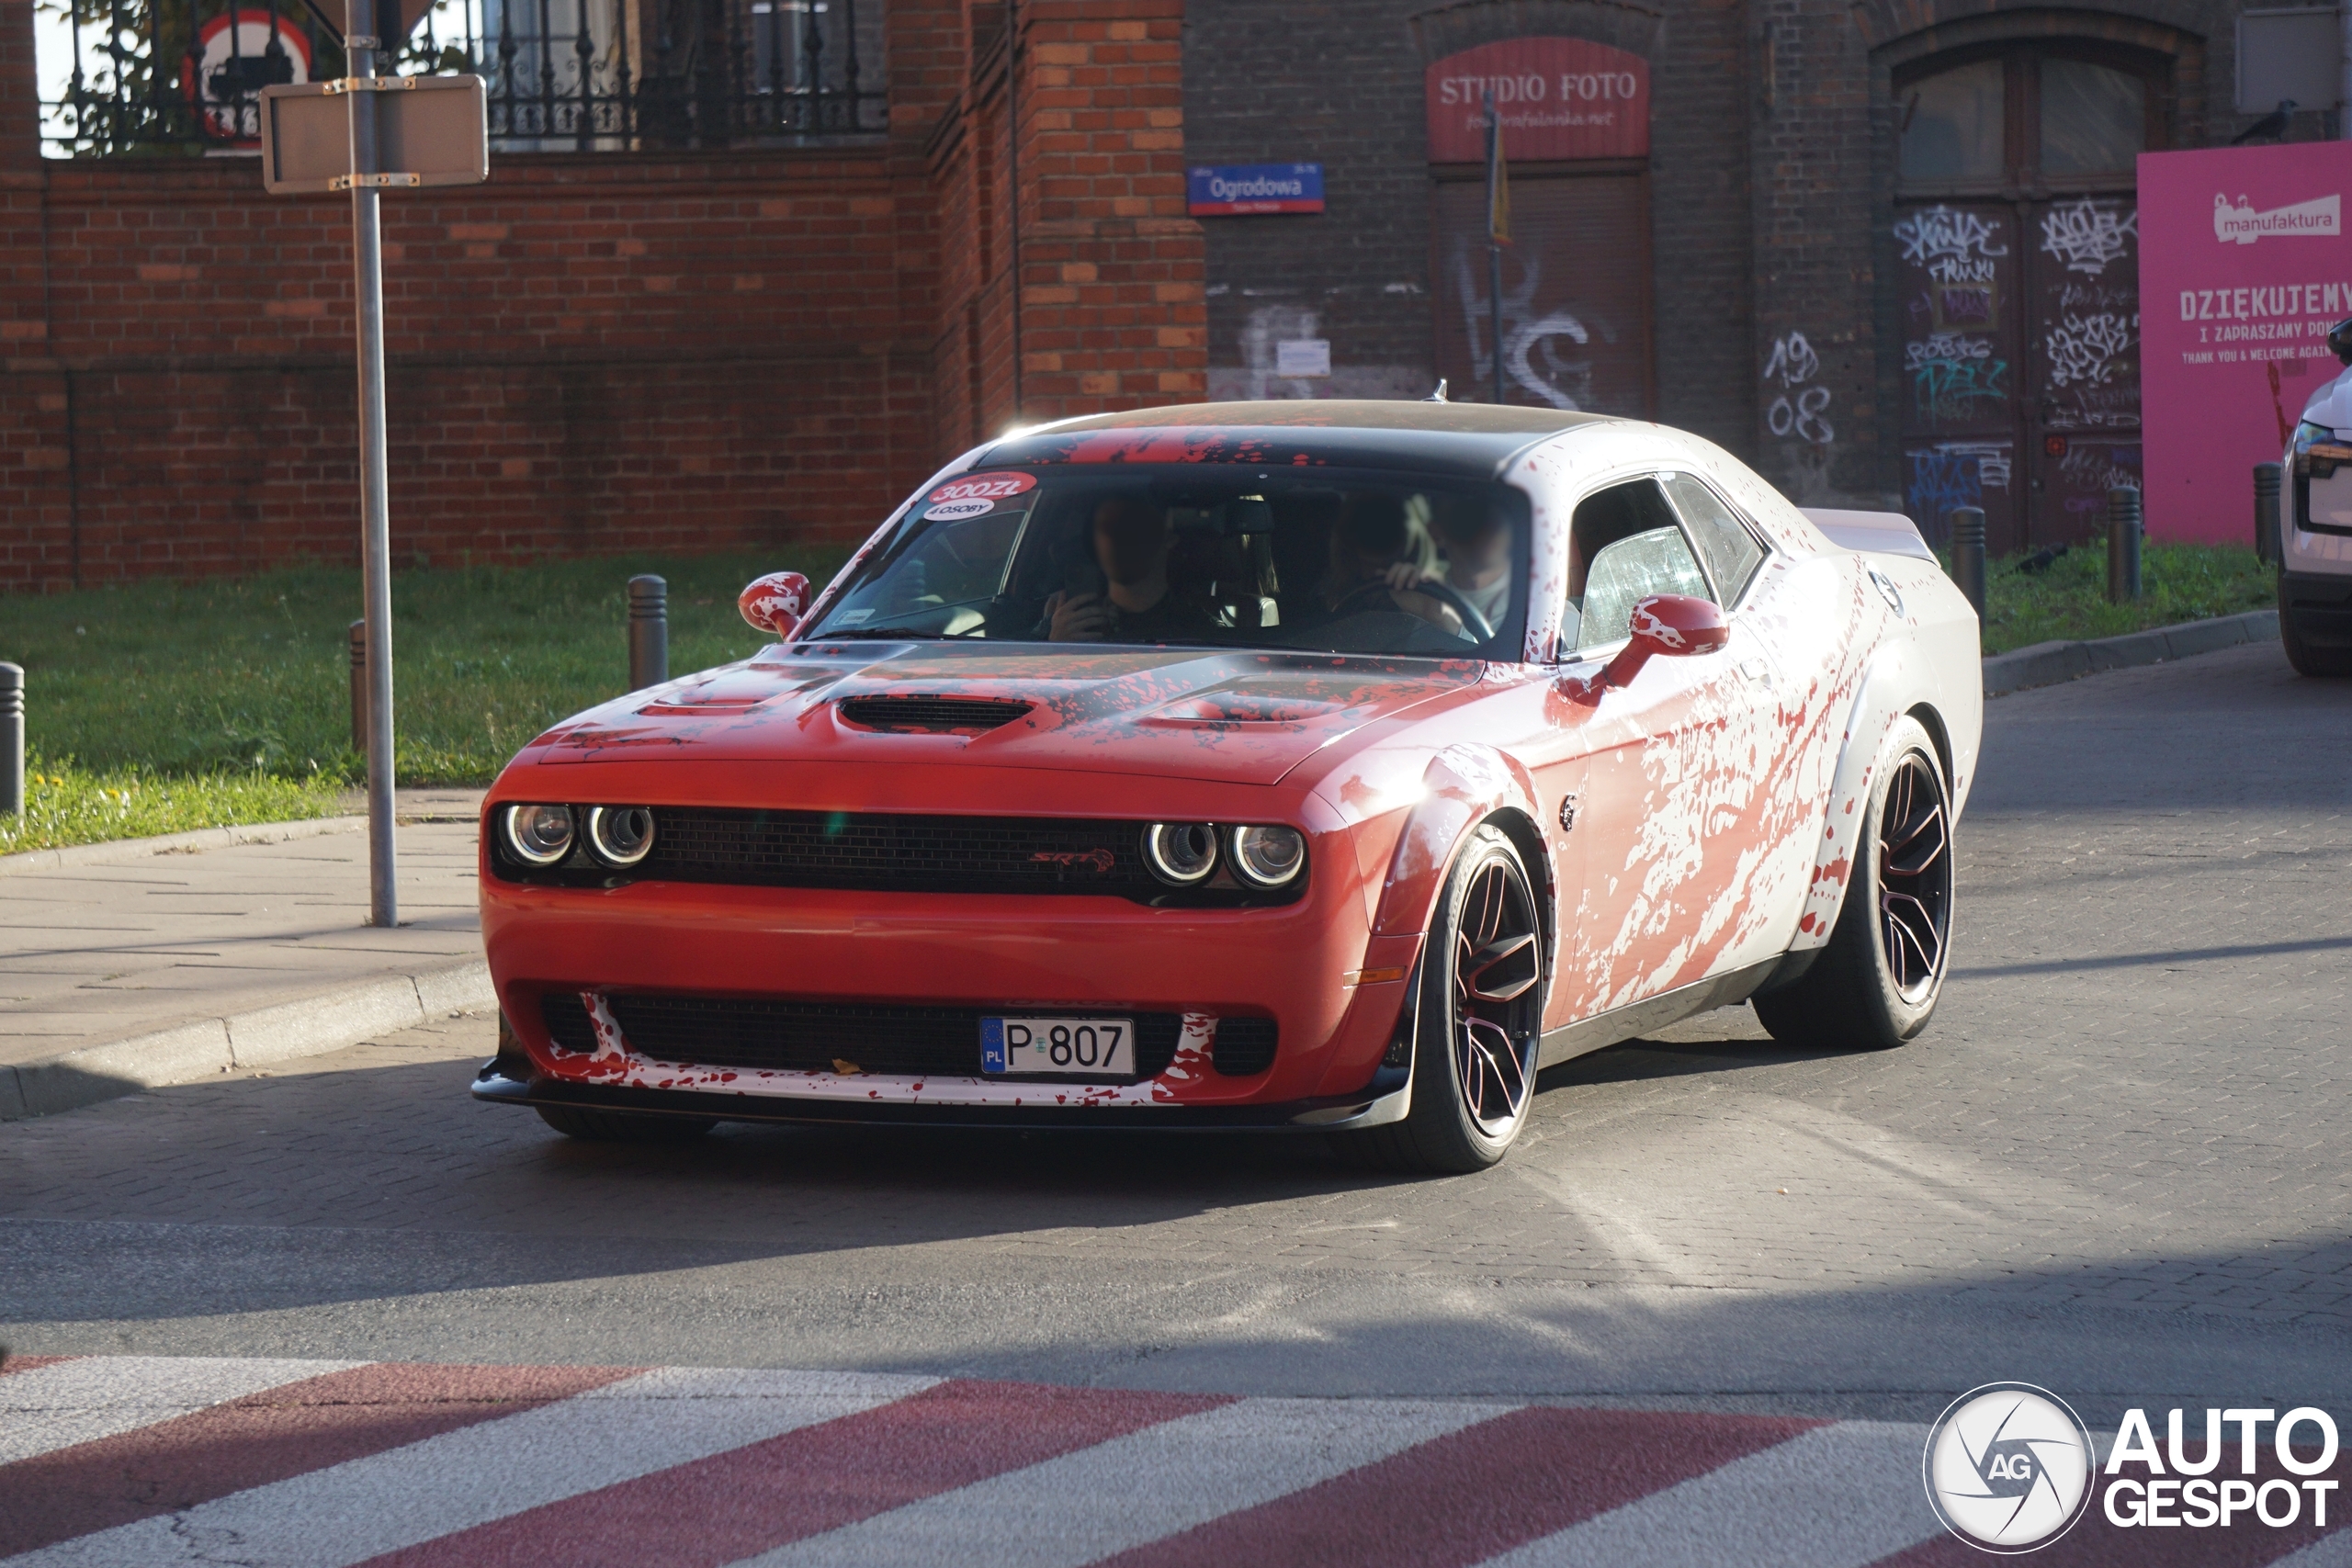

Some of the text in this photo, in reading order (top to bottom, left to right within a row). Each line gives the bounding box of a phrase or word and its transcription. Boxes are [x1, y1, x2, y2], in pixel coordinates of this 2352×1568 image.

[1439, 72, 1636, 104] STUDIO FOTO
[1209, 175, 1302, 202] Ogrodowa
[2223, 214, 2333, 233] manufaktura
[2180, 283, 2352, 321] DZIĘKUJEMY
[2200, 327, 2209, 344] I
[2215, 323, 2302, 343] ZAPRASZAMY
[2183, 345, 2332, 364] THANK YOU & WELCOME AGAIN
[939, 504, 989, 514] OSOBY
[1029, 852, 1097, 866] SRT
[1007, 1024, 1123, 1067] P 807
[986, 1051, 1002, 1063] PL
